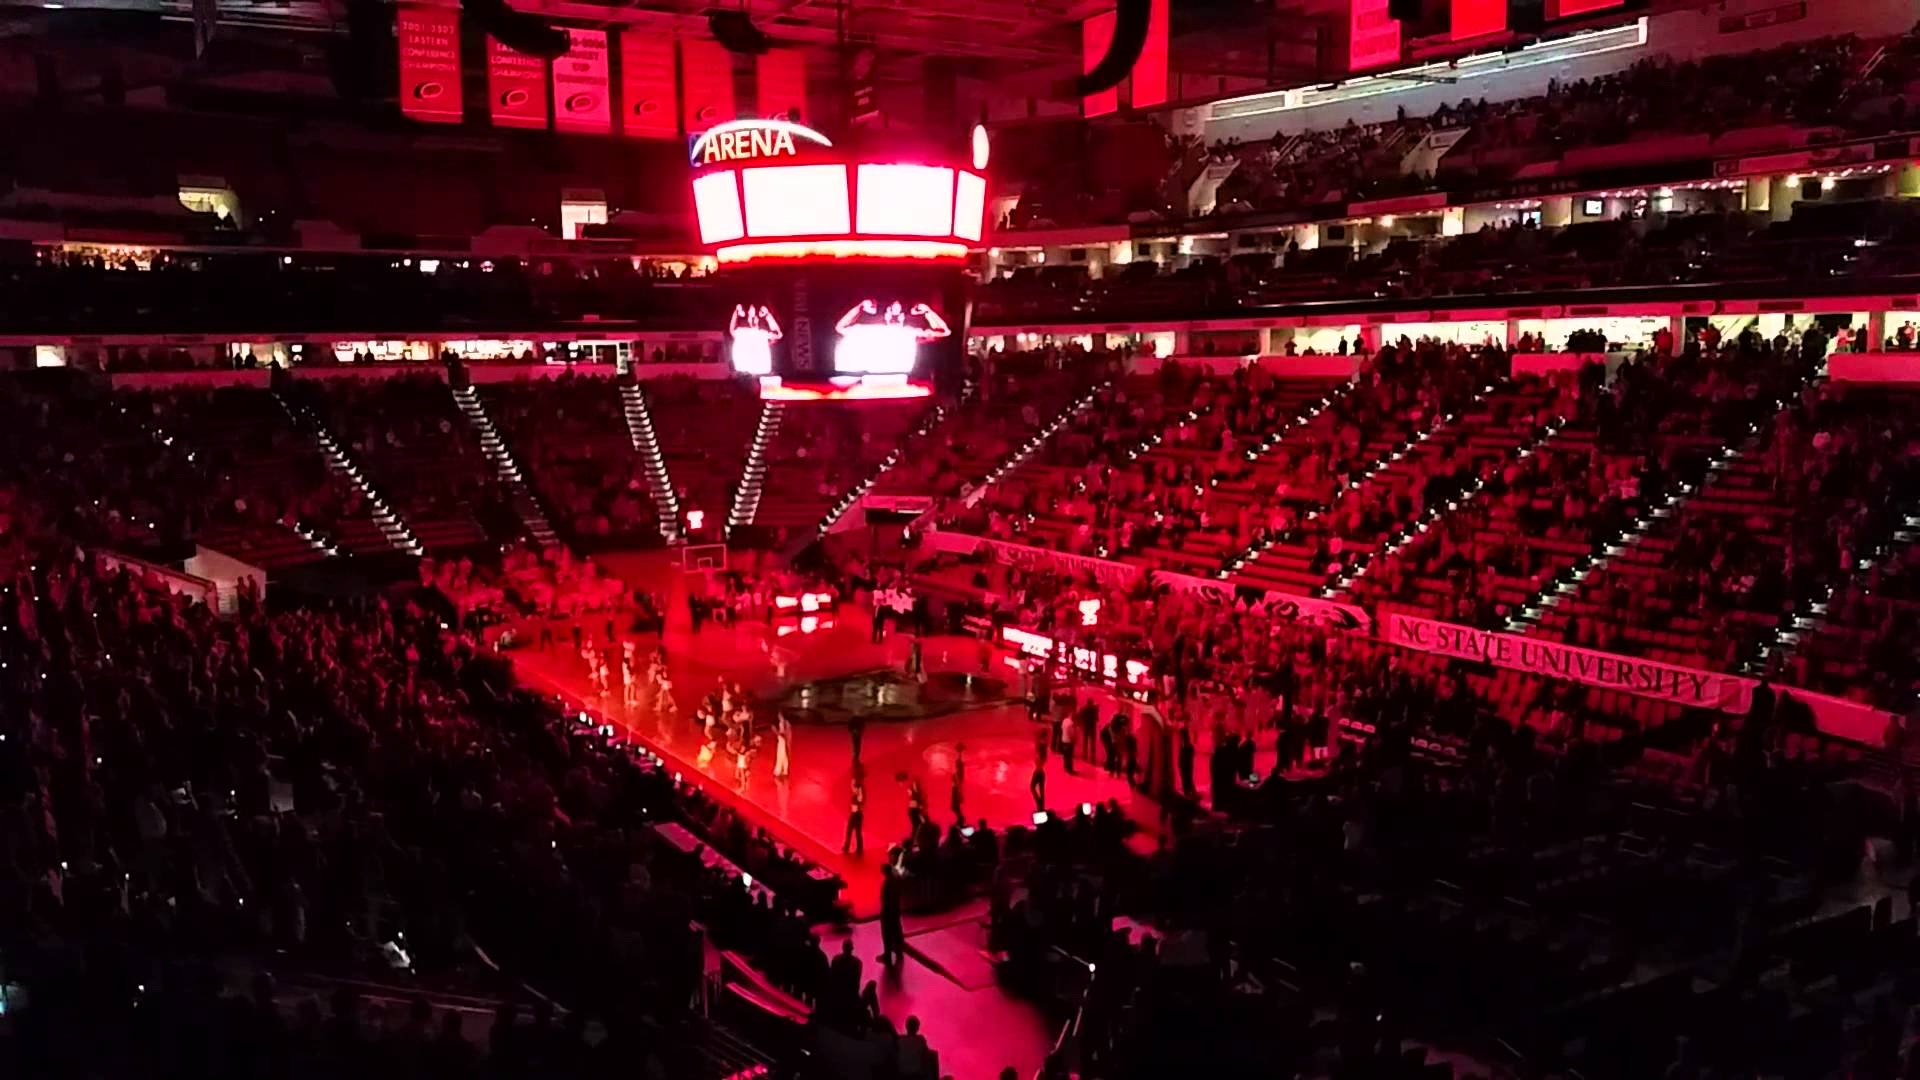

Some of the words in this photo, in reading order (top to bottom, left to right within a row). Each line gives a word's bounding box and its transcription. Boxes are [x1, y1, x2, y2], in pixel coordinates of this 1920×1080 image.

[408, 34, 449, 47] EASTERN
[703, 128, 796, 163] ARENA
[1399, 618, 1430, 645] NC
[1437, 626, 1512, 663] STATE
[1520, 640, 1710, 700] UNIVERSITY
